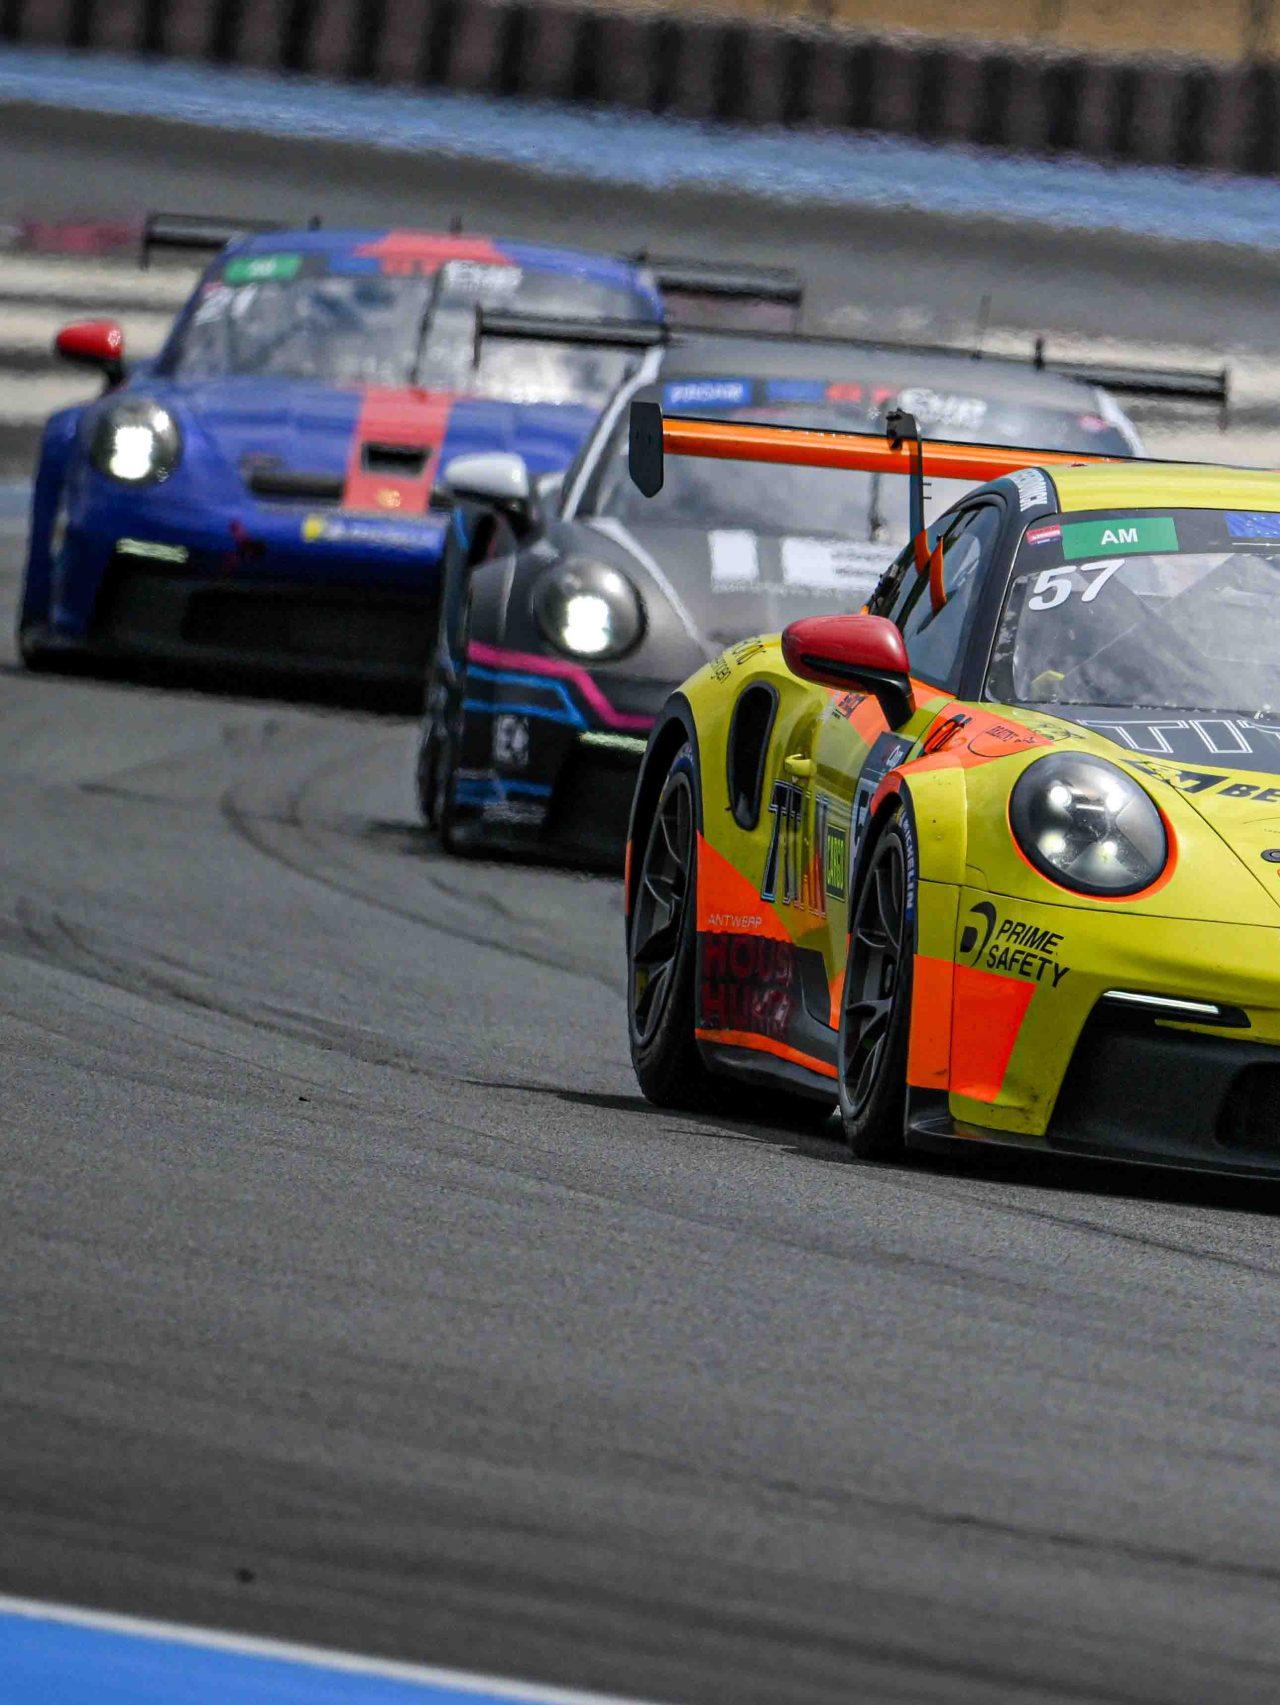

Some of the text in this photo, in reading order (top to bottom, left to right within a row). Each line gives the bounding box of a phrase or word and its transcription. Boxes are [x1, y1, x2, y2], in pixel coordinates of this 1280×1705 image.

[1101, 527, 1139, 546] AM
[1028, 558, 1127, 612] 57
[995, 918, 1065, 955] PRIME
[986, 944, 1071, 989] SAFETY
